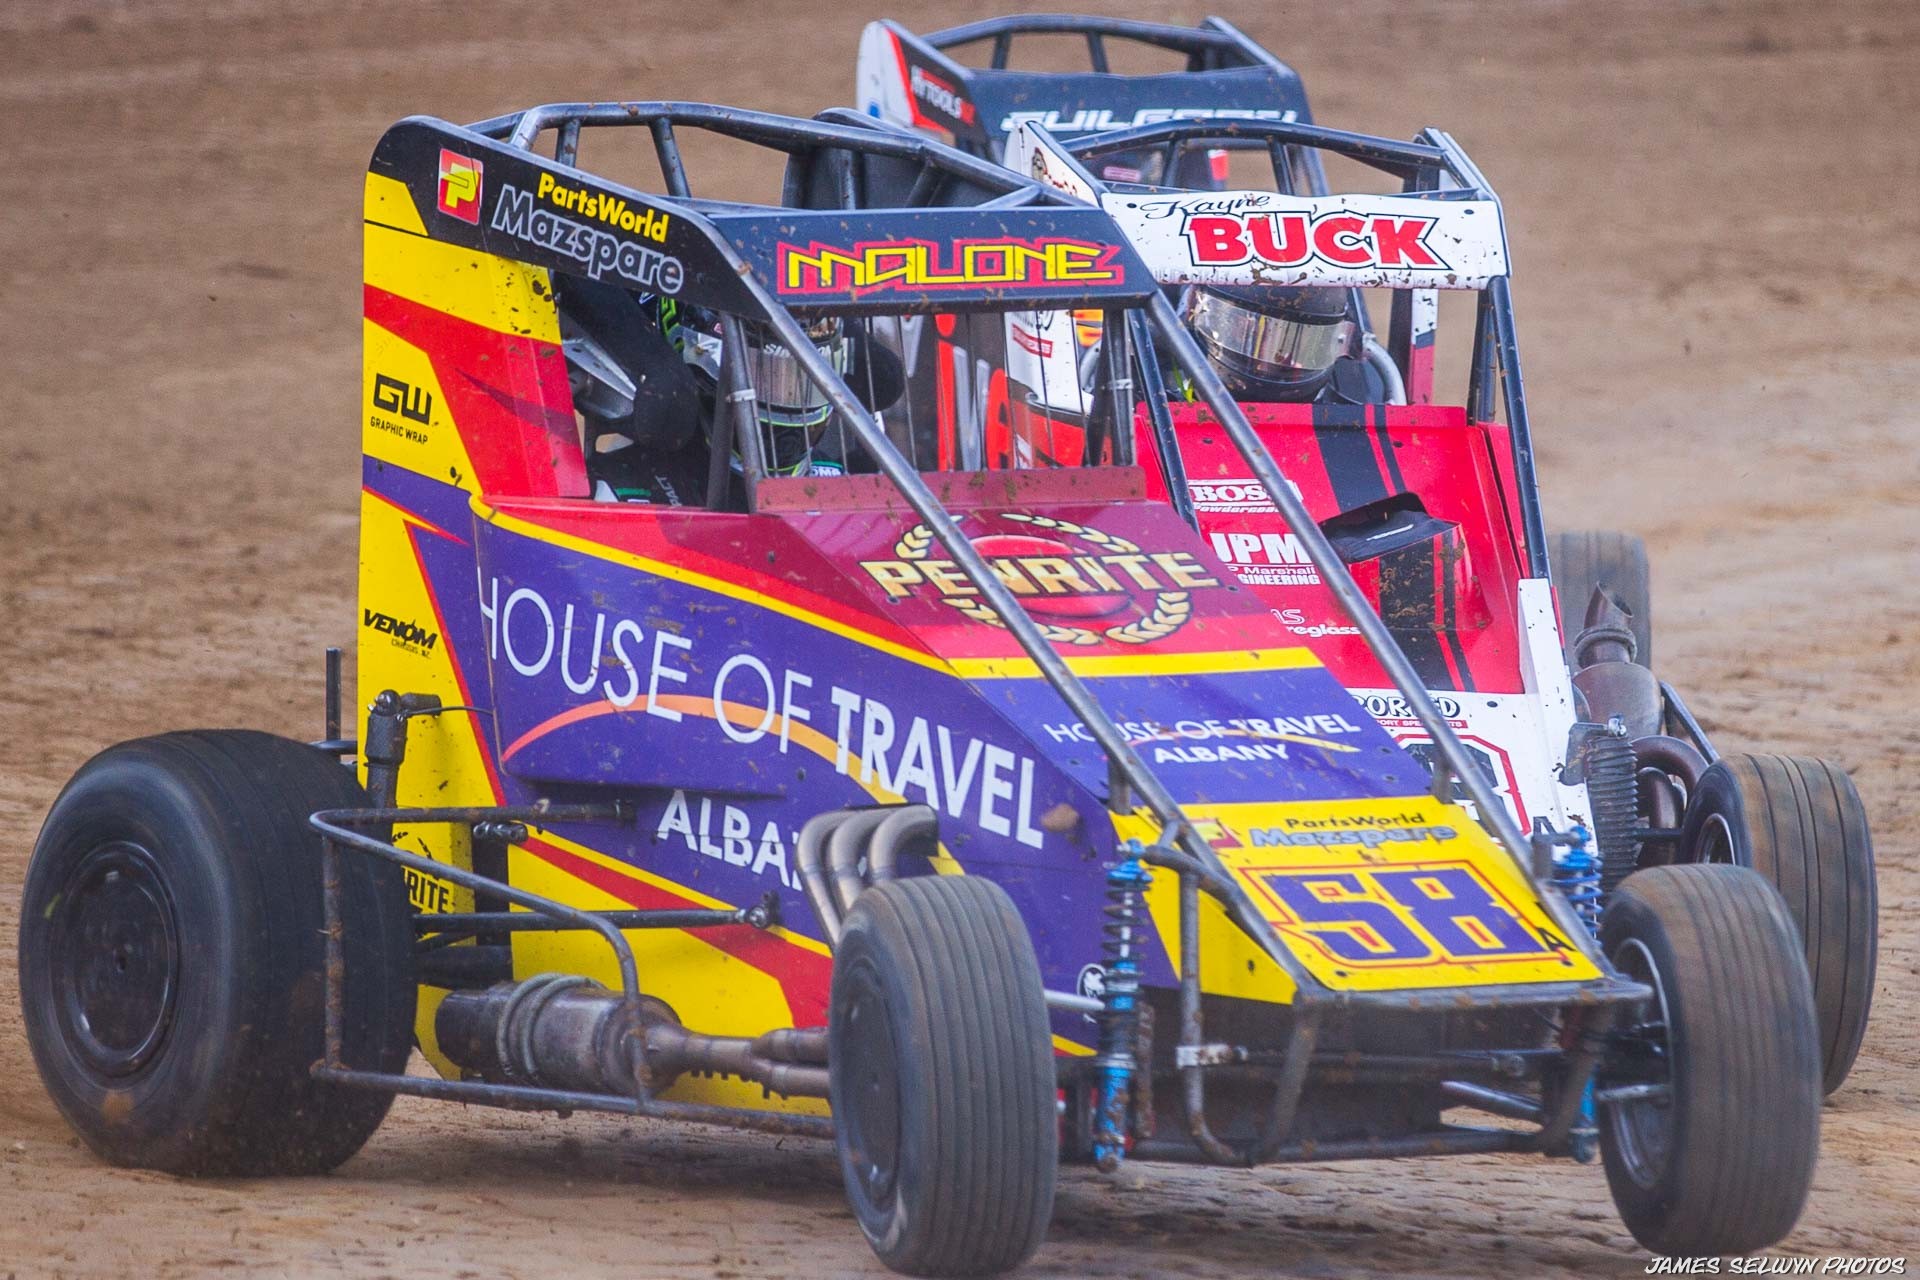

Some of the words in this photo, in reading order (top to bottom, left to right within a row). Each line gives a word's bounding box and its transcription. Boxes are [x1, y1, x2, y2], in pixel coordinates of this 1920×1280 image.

[538, 172, 669, 243] PartsWorld
[1139, 194, 1271, 219] Kayne
[491, 185, 684, 294] Mazspare
[1188, 214, 1440, 267] BUCK
[786, 242, 1114, 289] MALONE
[373, 372, 432, 426] GW
[370, 416, 404, 437] GRAPHIC
[405, 428, 428, 445] WRAP
[859, 552, 1220, 598] PENRITE
[1237, 574, 1321, 585] GINEERING
[364, 608, 438, 649] VENOM
[1285, 624, 1361, 637] reglass
[477, 566, 692, 723] HOUSE
[712, 653, 813, 754] OF
[830, 685, 1044, 850] TRAVEL
[1174, 719, 1230, 740] OF
[1229, 714, 1362, 739] TRAVEL
[1154, 743, 1286, 764] ALBANY
[656, 789, 803, 892] ALBA
[1249, 826, 1459, 849] Mazspare
[1285, 812, 1426, 828] PartsWorld
[404, 869, 450, 913] RITE
[1261, 868, 1548, 961] 58
